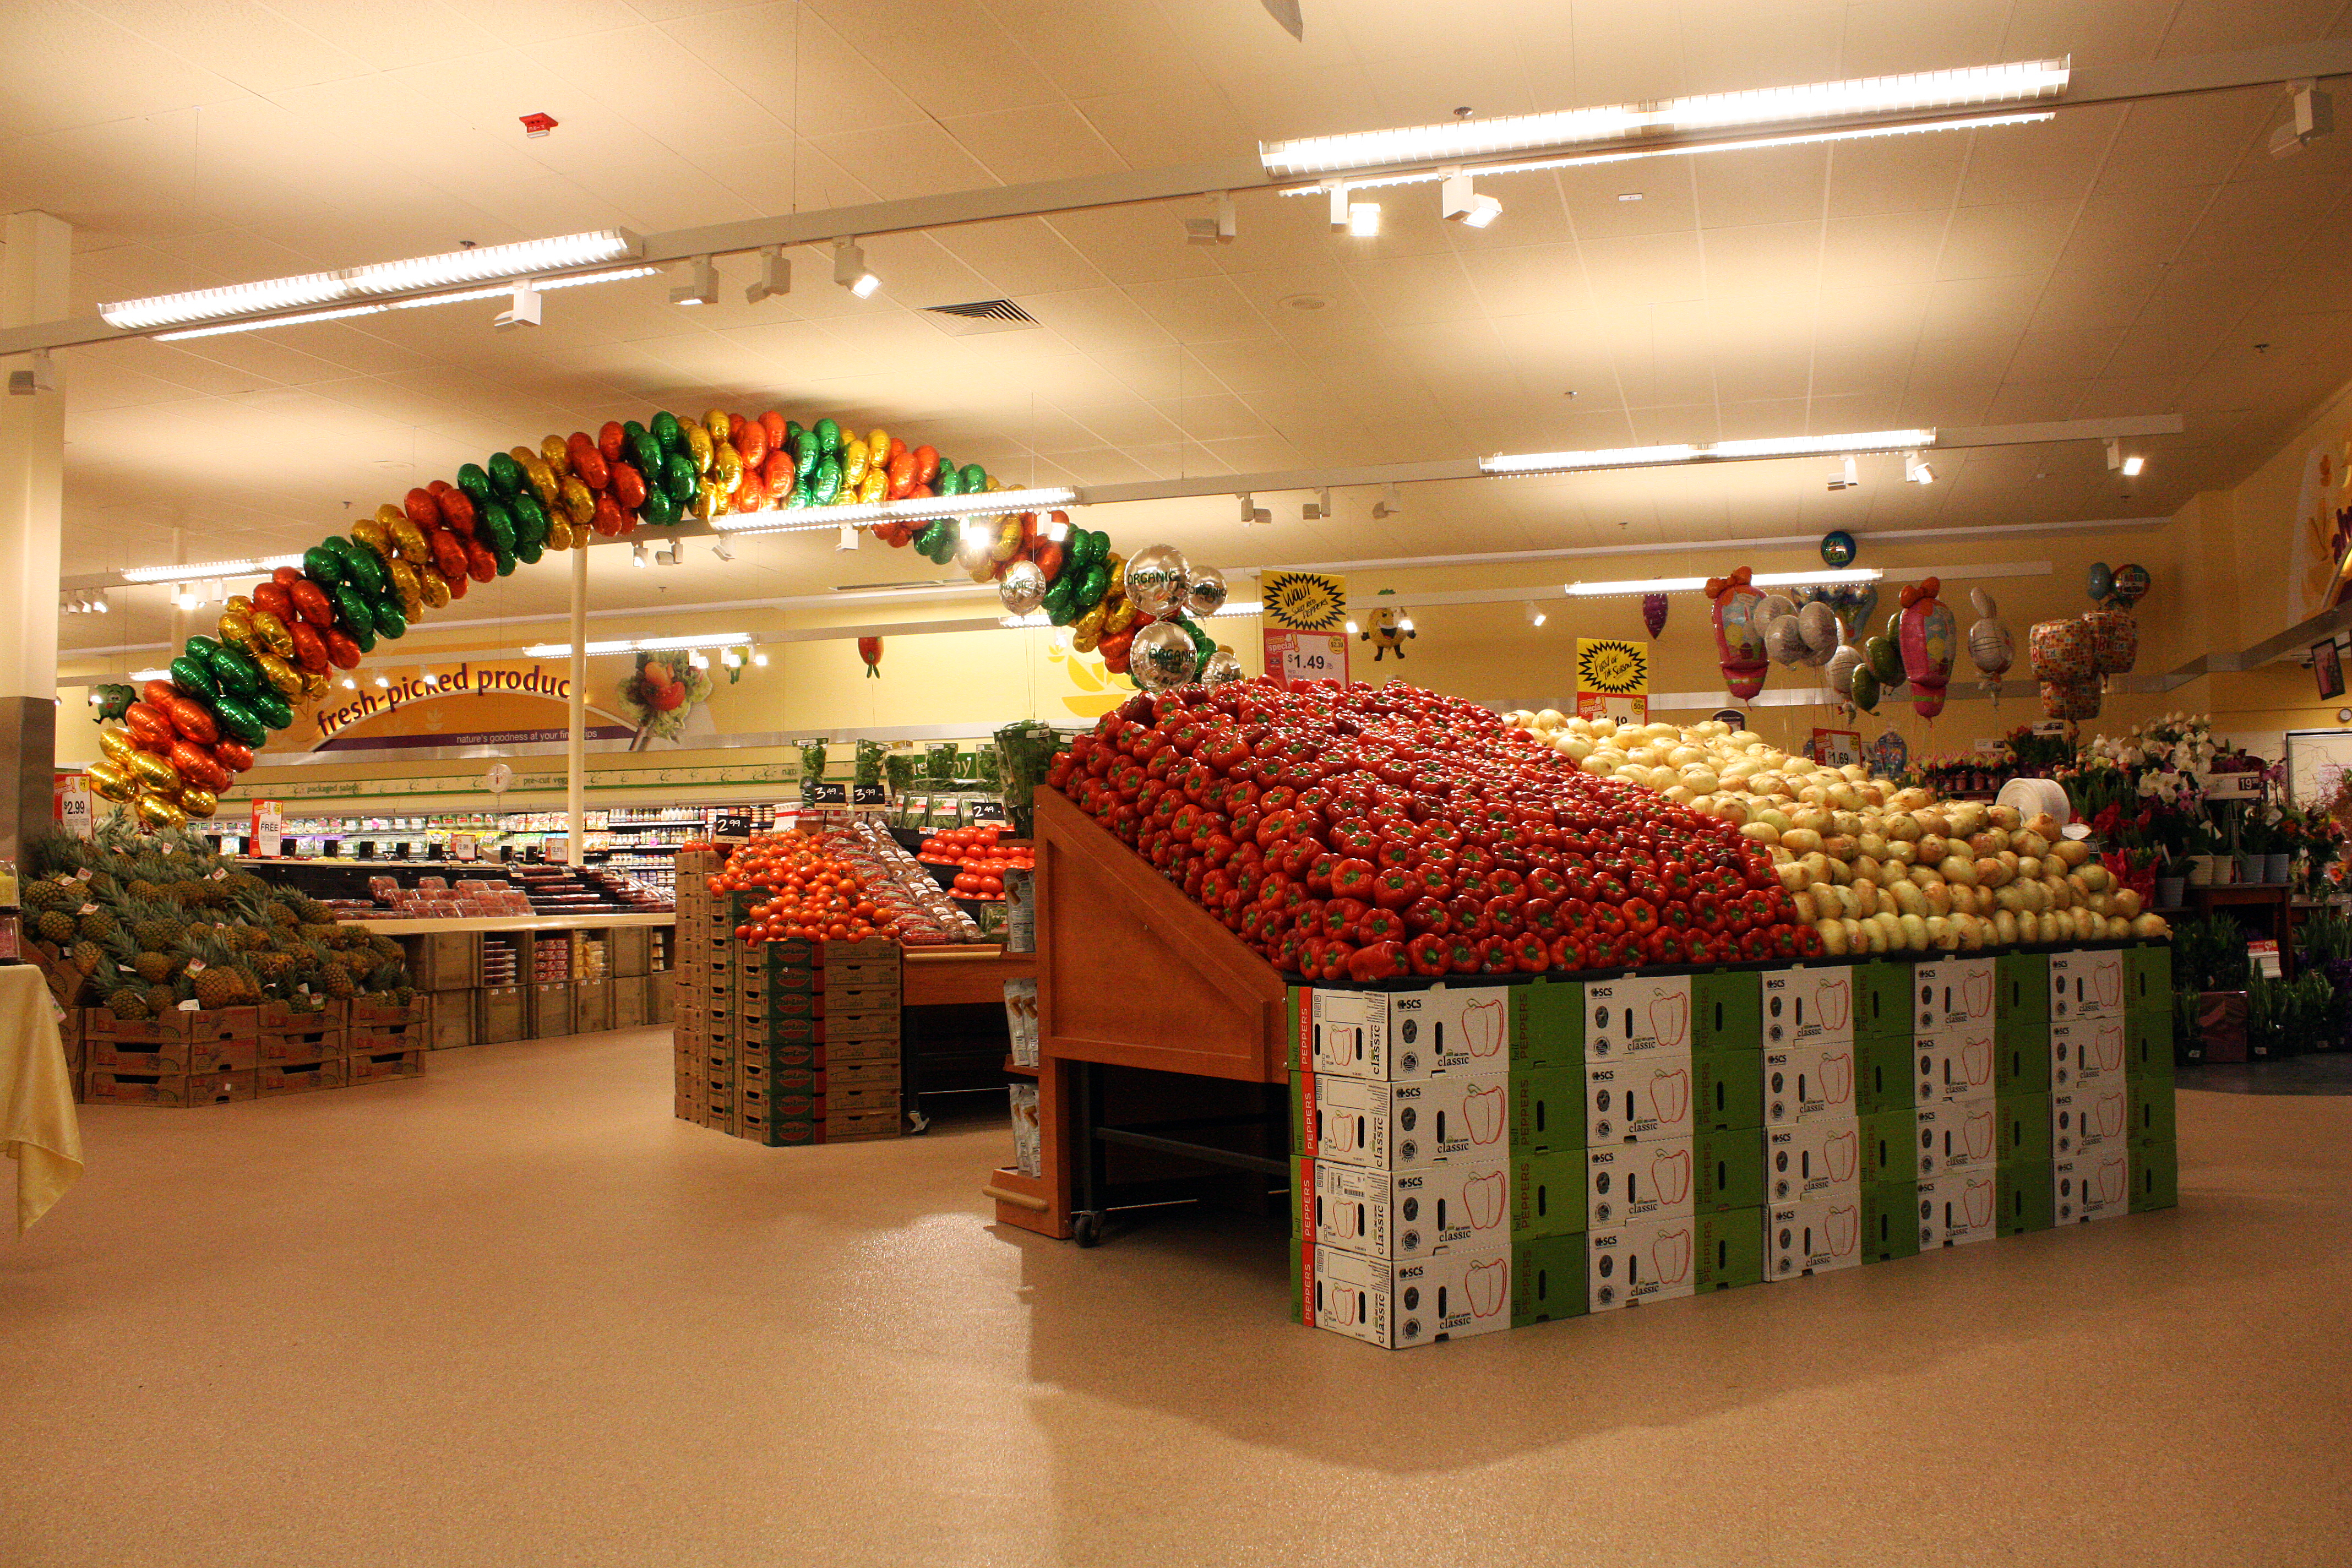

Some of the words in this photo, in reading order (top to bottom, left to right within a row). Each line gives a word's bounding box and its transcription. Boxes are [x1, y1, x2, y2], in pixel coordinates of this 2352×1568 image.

[1128, 571, 1177, 584] ORGANIC
[1190, 586, 1227, 597] ORGANIC
[1303, 598, 1328, 619] PEPPERS
[1306, 599, 1316, 609] RED
[1288, 654, 1324, 669] $1.49
[318, 663, 469, 736] fresh-picked
[478, 665, 586, 697] produc
[456, 734, 487, 744] nature's
[489, 731, 528, 745] goodness
[540, 732, 558, 742] your
[524, 777, 549, 786] pre-cut
[307, 784, 337, 794] packaged
[64, 801, 85, 814] $2.99
[1520, 994, 1528, 1059] PEPPERS
[1797, 1027, 1822, 1037] classic
[1371, 1025, 1380, 1074] classic
[1627, 1039, 1656, 1051] classic
[1438, 1055, 1469, 1066] classic
[1702, 1063, 1711, 1124] PEPPERS
[1521, 1079, 1529, 1146] PEPPERS
[1800, 1103, 1825, 1113] classic
[1305, 1093, 1314, 1150] PEPPERS
[1629, 1121, 1658, 1133] classic
[1374, 1118, 1383, 1167] classic
[1437, 1142, 1469, 1153] classic
[1804, 1179, 1829, 1191] classic
[1521, 1163, 1530, 1229] PEPPERS
[1303, 1179, 1311, 1237] PEPPERS
[1629, 1202, 1658, 1215] classic
[1375, 1205, 1384, 1255] classic
[1439, 1229, 1471, 1242] classic
[1704, 1221, 1712, 1282] PEPPERS
[1806, 1256, 1830, 1266] classic
[1522, 1250, 1531, 1315] PEPPERS
[1631, 1284, 1659, 1297] classic
[1375, 1294, 1385, 1344] classic
[1440, 1317, 1471, 1330] classic
